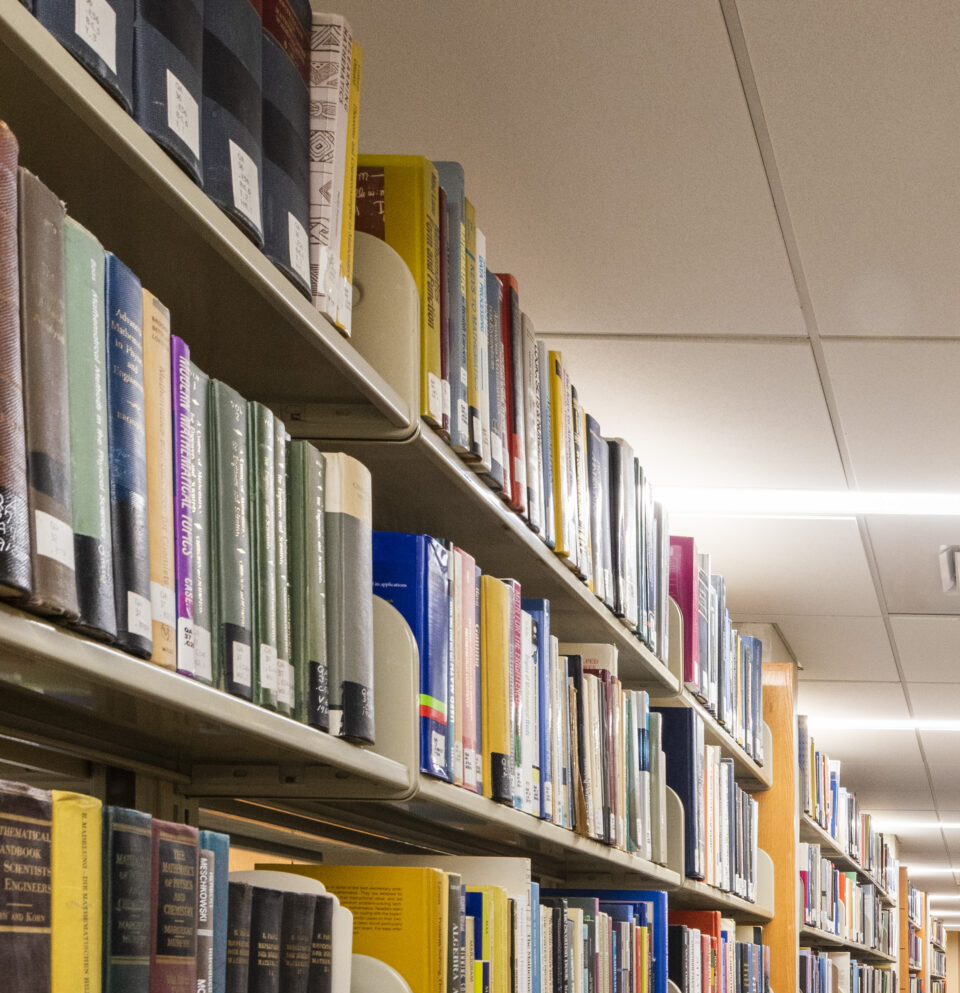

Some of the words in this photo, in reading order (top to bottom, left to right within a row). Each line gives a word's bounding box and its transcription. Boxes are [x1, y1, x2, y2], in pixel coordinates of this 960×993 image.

[425, 214, 436, 249] Form
[426, 250, 436, 272] and
[427, 272, 437, 330] Function
[91, 289, 102, 365] Mathematical
[94, 366, 103, 411] Methods
[179, 355, 192, 409] MODERN
[97, 449, 107, 492] Physical
[181, 413, 193, 509] MATHEMATICAL
[99, 494, 108, 541] Sciences
[182, 514, 193, 556] TOPICS
[381, 582, 407, 590] applications
[4, 877, 51, 894] ENGINEERS
[162, 861, 195, 876] MATHEMATICS
[199, 857, 208, 923] MESCHKOWSKI
[11, 912, 24, 922] AND
[26, 911, 46, 923] KORN
[452, 922, 461, 981] ALGEBRA
